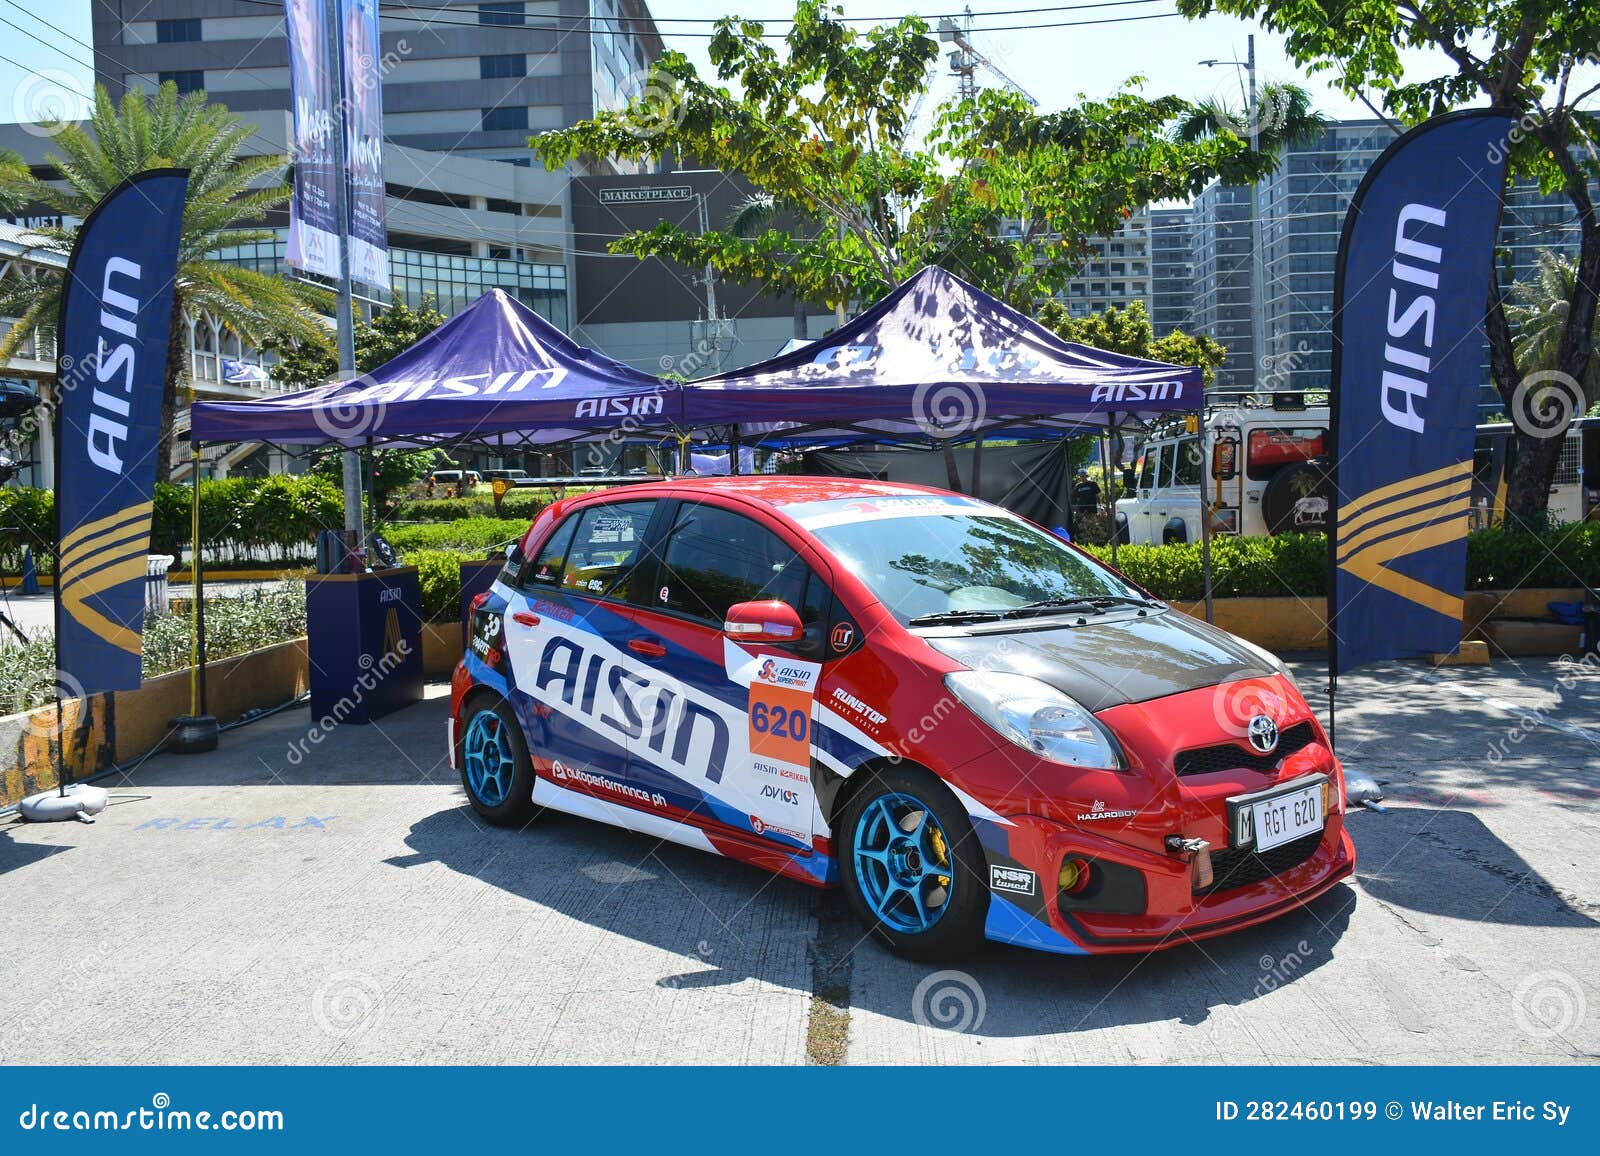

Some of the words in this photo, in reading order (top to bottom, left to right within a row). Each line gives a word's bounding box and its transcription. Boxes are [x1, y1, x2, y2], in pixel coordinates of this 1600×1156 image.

[604, 188, 689, 201] MARKETPLACE
[1380, 203, 1447, 434] AISIN
[87, 256, 141, 475] AISIN
[344, 368, 569, 403] AISIN
[1090, 381, 1184, 402] AISIN
[575, 395, 664, 418] AISIN
[380, 588, 402, 603] AISIN
[780, 667, 811, 680] AISIN
[536, 635, 729, 785] AISIN
[832, 687, 888, 725] RUNSTOP
[752, 701, 807, 742] 620
[753, 762, 778, 775] AISIN
[133, 816, 340, 831] RELAX
[1077, 810, 1138, 821] HAZARDBOY
[1264, 805, 1287, 838] RGT
[1294, 797, 1316, 827] 620
[993, 868, 1032, 884] NSR
